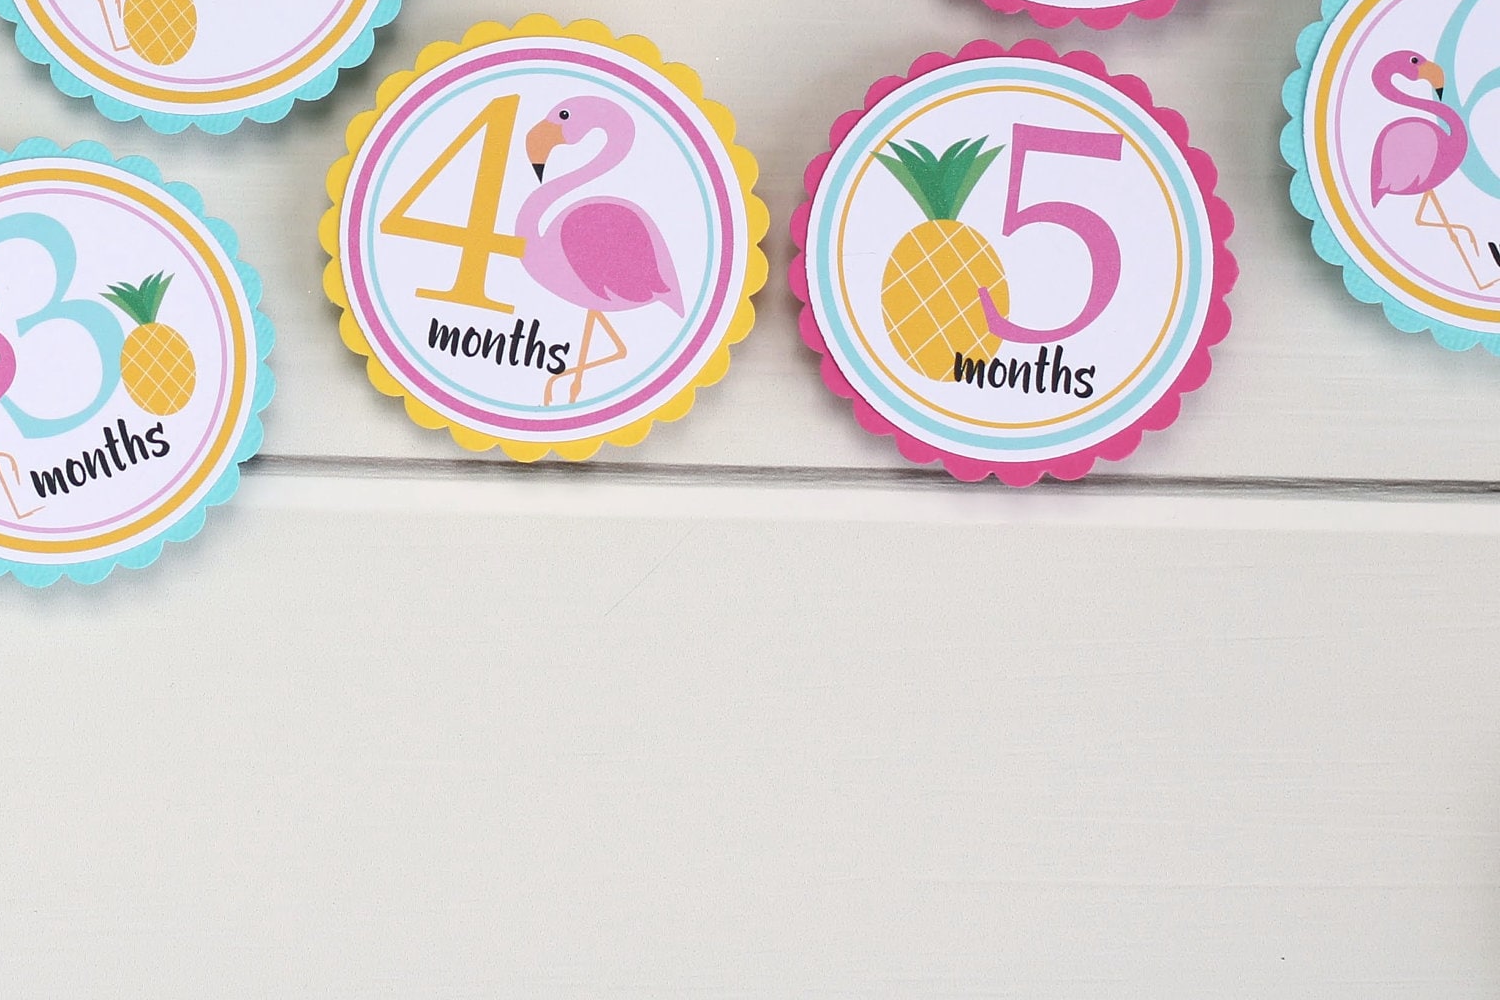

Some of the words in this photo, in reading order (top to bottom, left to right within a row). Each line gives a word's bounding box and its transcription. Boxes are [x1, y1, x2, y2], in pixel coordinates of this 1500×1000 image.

[379, 93, 527, 315] 4
[977, 122, 1125, 345] 5
[427, 316, 571, 376] months
[953, 344, 1096, 400] months
[28, 417, 171, 499] months
